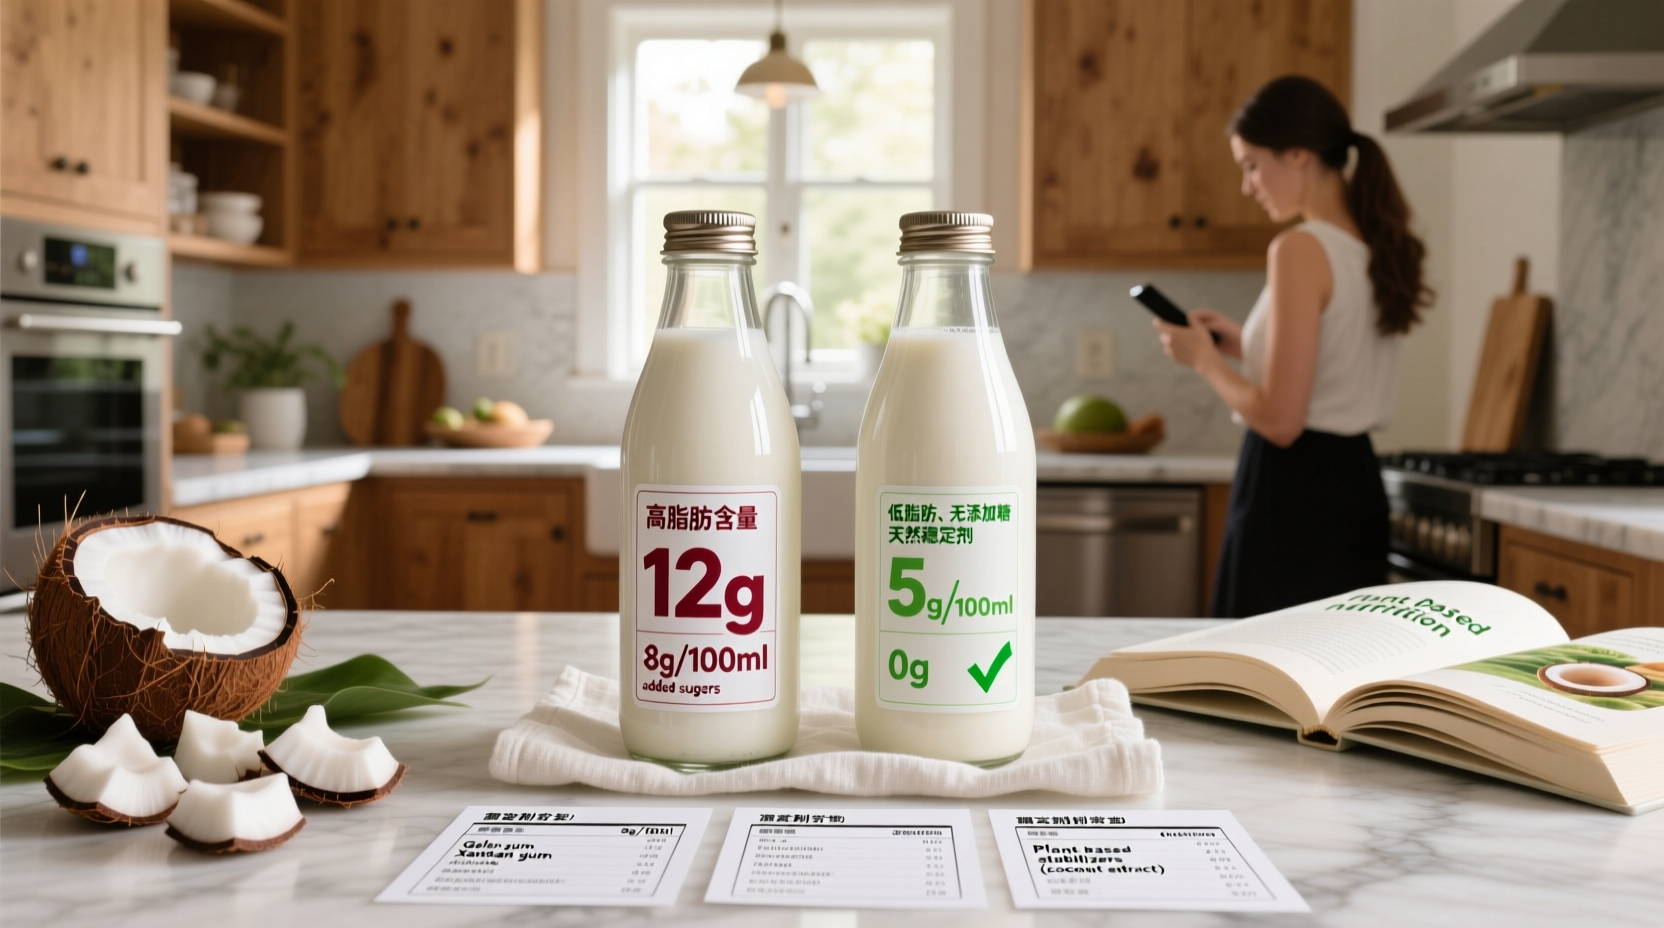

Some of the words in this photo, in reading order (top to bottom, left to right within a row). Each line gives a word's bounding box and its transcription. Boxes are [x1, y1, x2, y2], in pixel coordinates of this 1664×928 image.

[646, 503, 758, 531] 高脂肪含量
[643, 547, 765, 635] 12g
[643, 643, 768, 679] 8g/100ml
[888, 649, 929, 689] 0g
[642, 679, 676, 694] added
